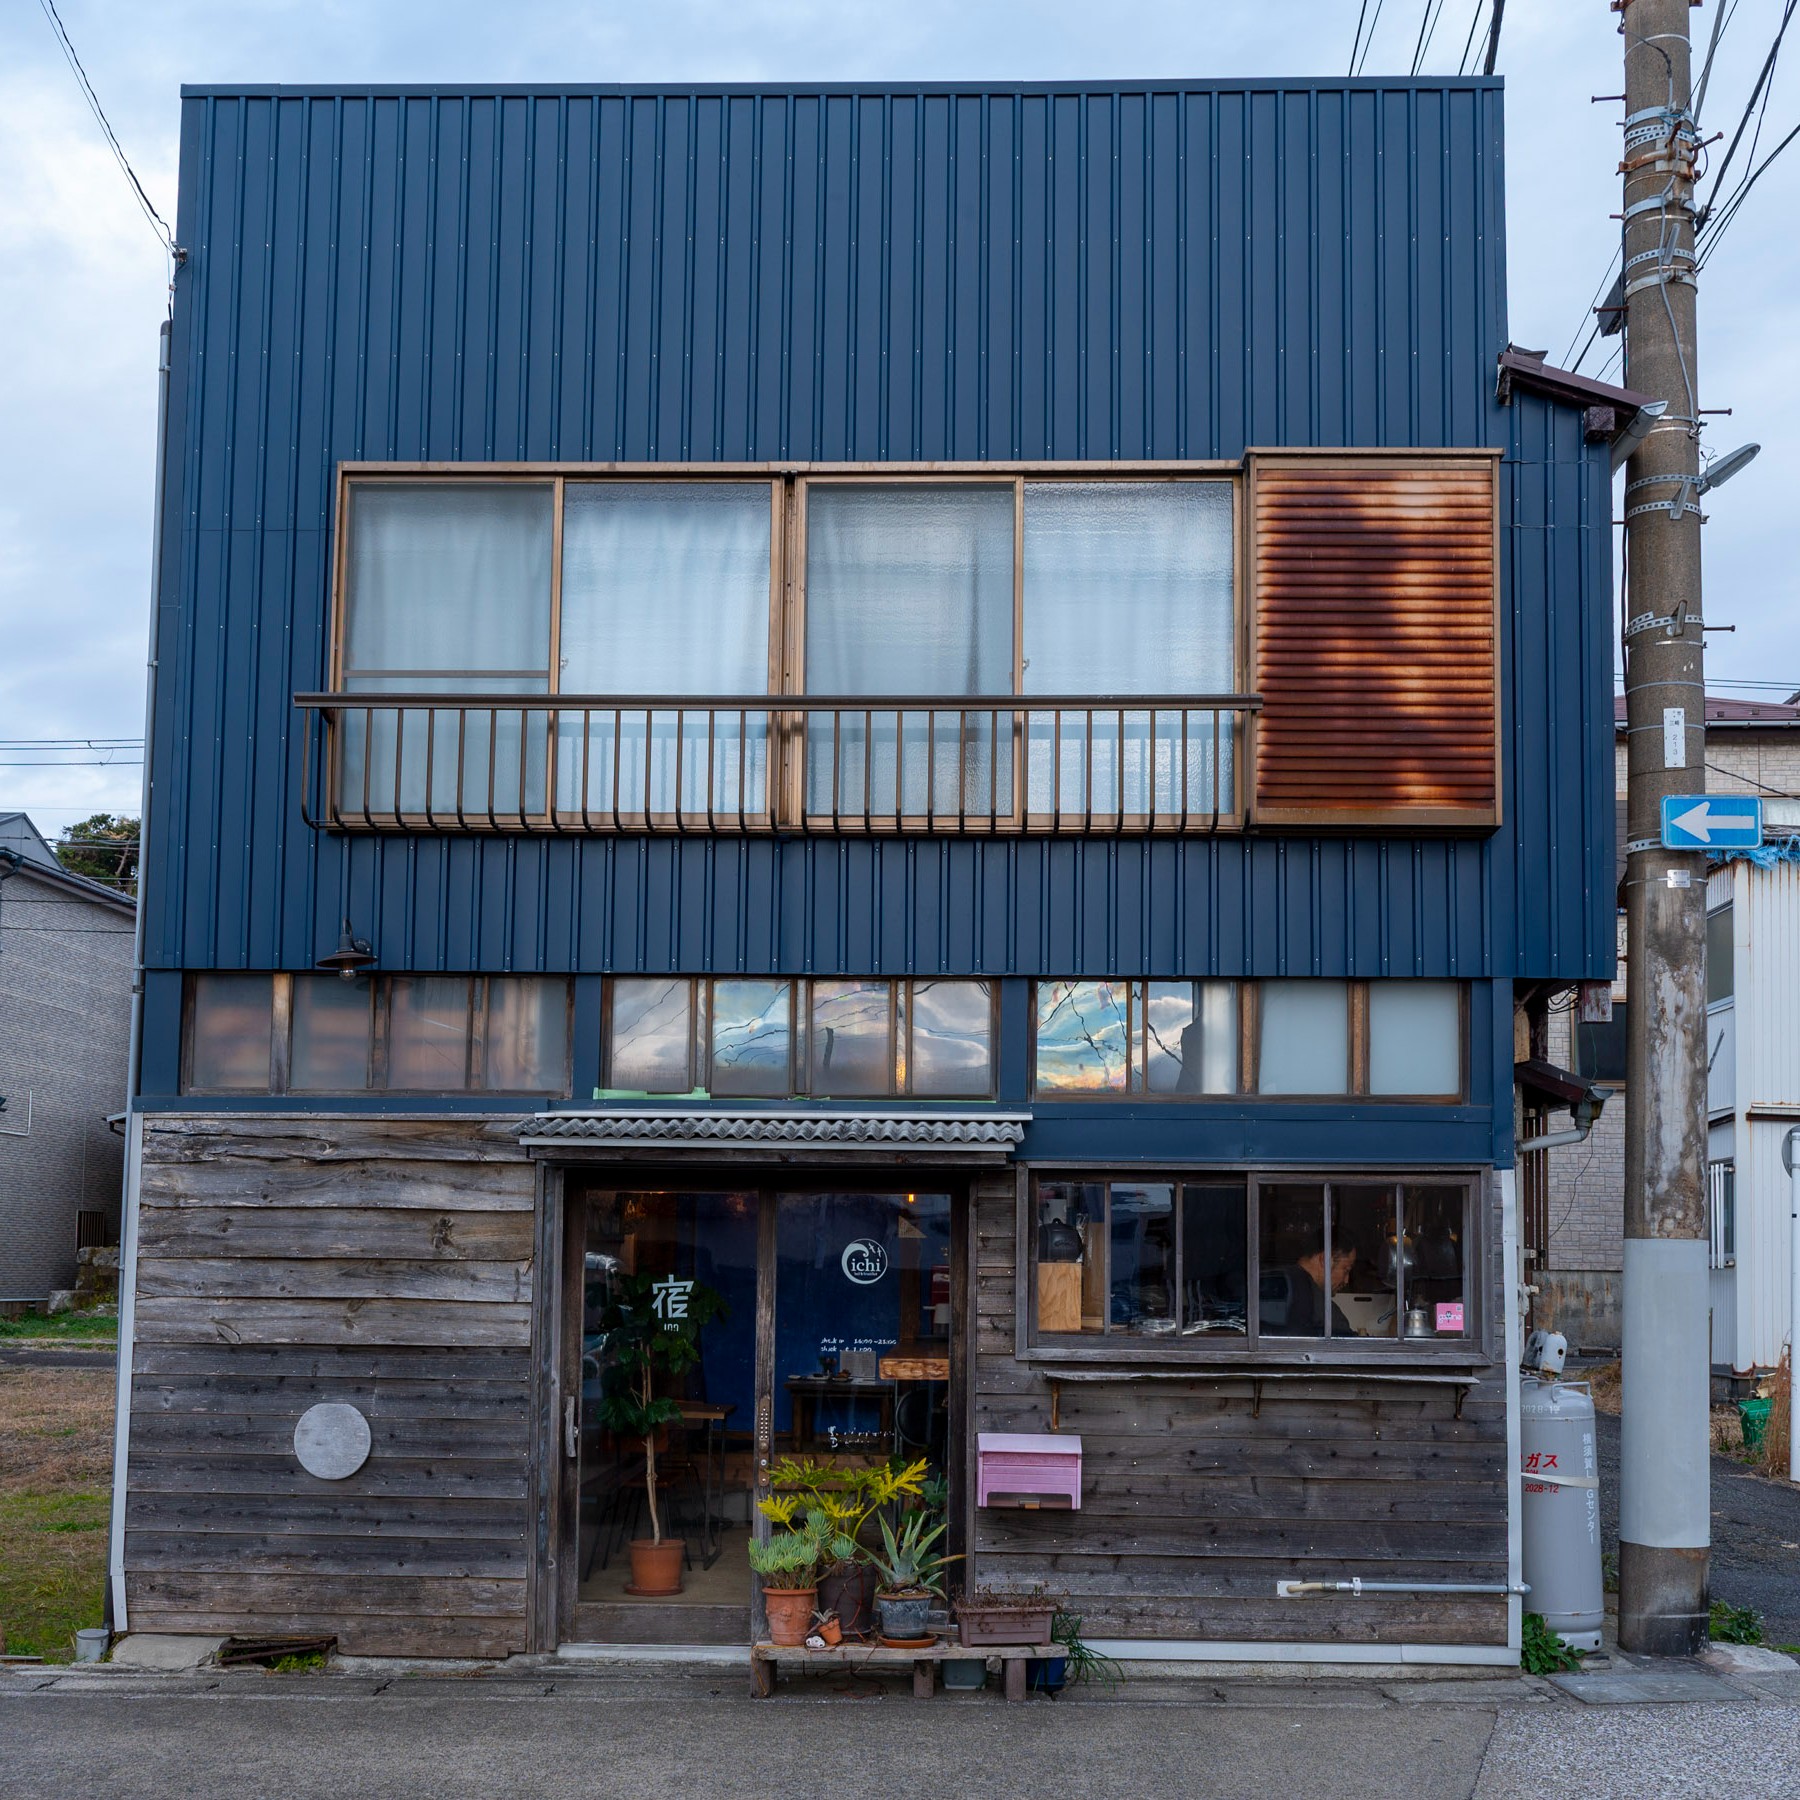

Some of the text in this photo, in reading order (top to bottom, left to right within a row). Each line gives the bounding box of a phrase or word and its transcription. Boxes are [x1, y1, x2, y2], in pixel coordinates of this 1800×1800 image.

[851, 1258, 881, 1272] ichi
[652, 1274, 694, 1318] 宿
[664, 1323, 679, 1331] inn
[1521, 1452, 1558, 1468] ガス
[1524, 1483, 1559, 1494] 2028-12
[1582, 1433, 1596, 1544] 横須賀LGセンター
